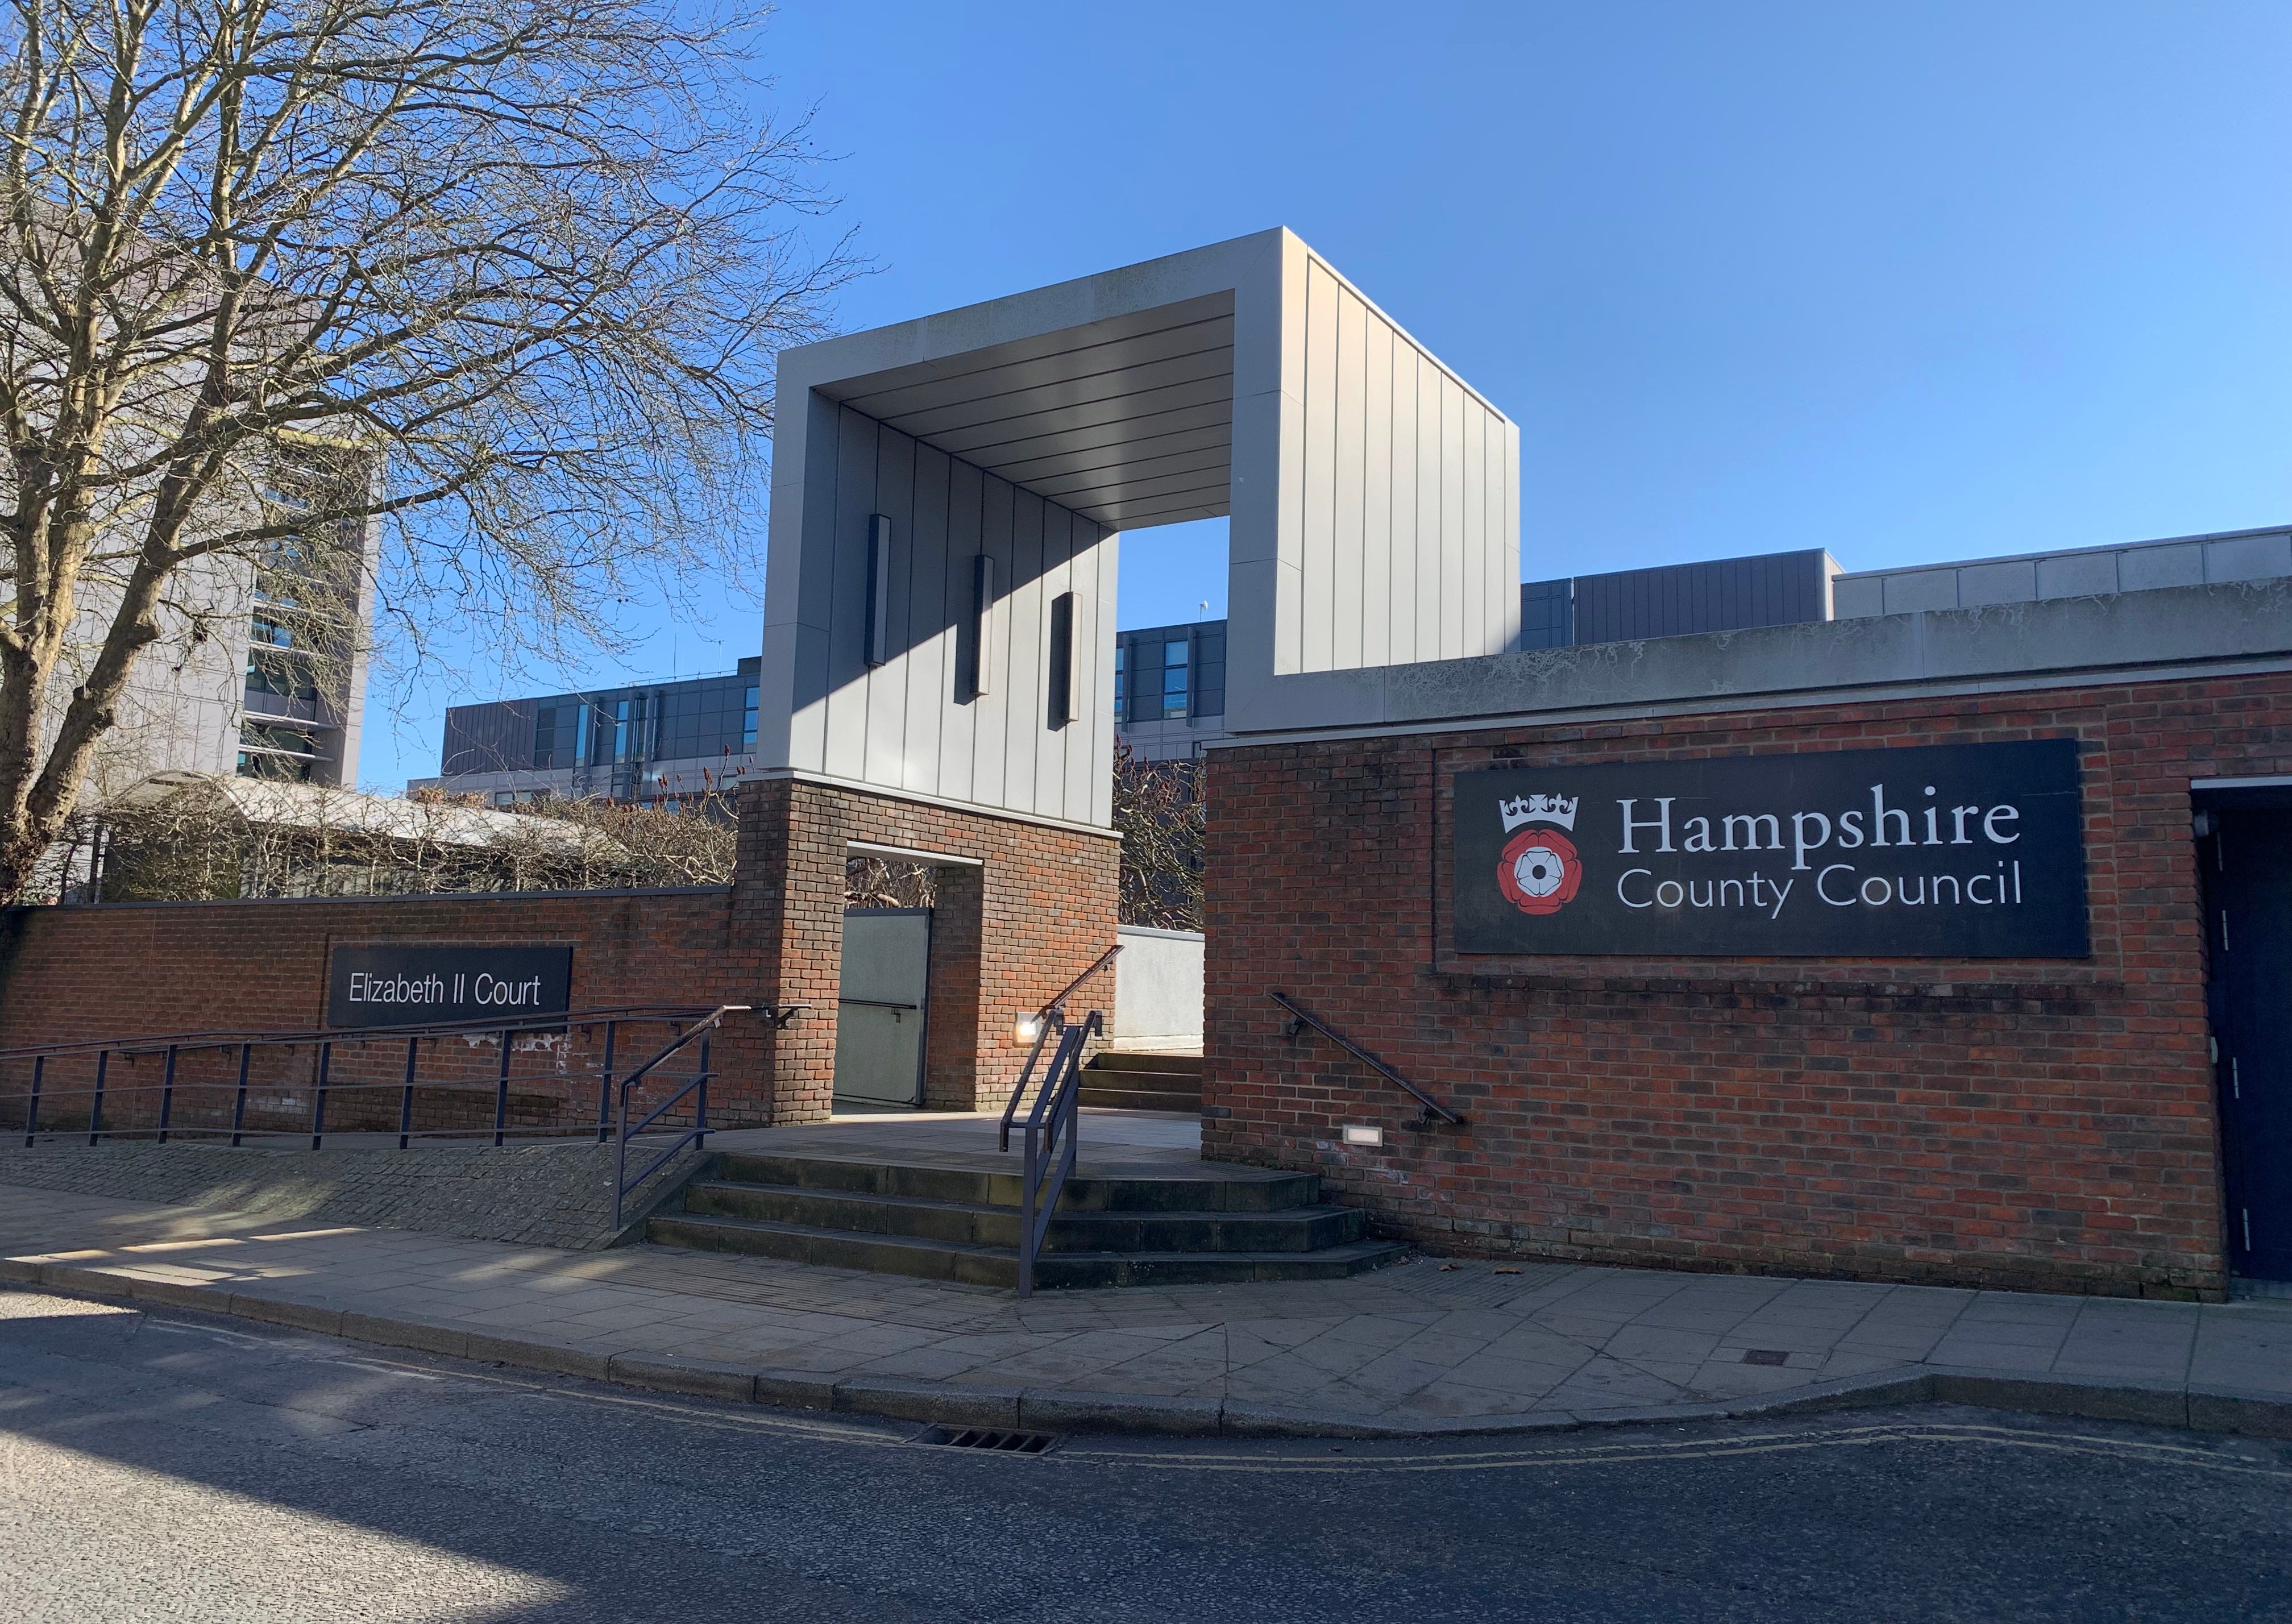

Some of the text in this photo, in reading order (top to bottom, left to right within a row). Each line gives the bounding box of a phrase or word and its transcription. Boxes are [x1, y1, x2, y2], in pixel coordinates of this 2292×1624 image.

[1616, 783, 2020, 870] Hampshire
[1617, 860, 2021, 920] County Council
[349, 973, 541, 1006] Elizabeth II Court
